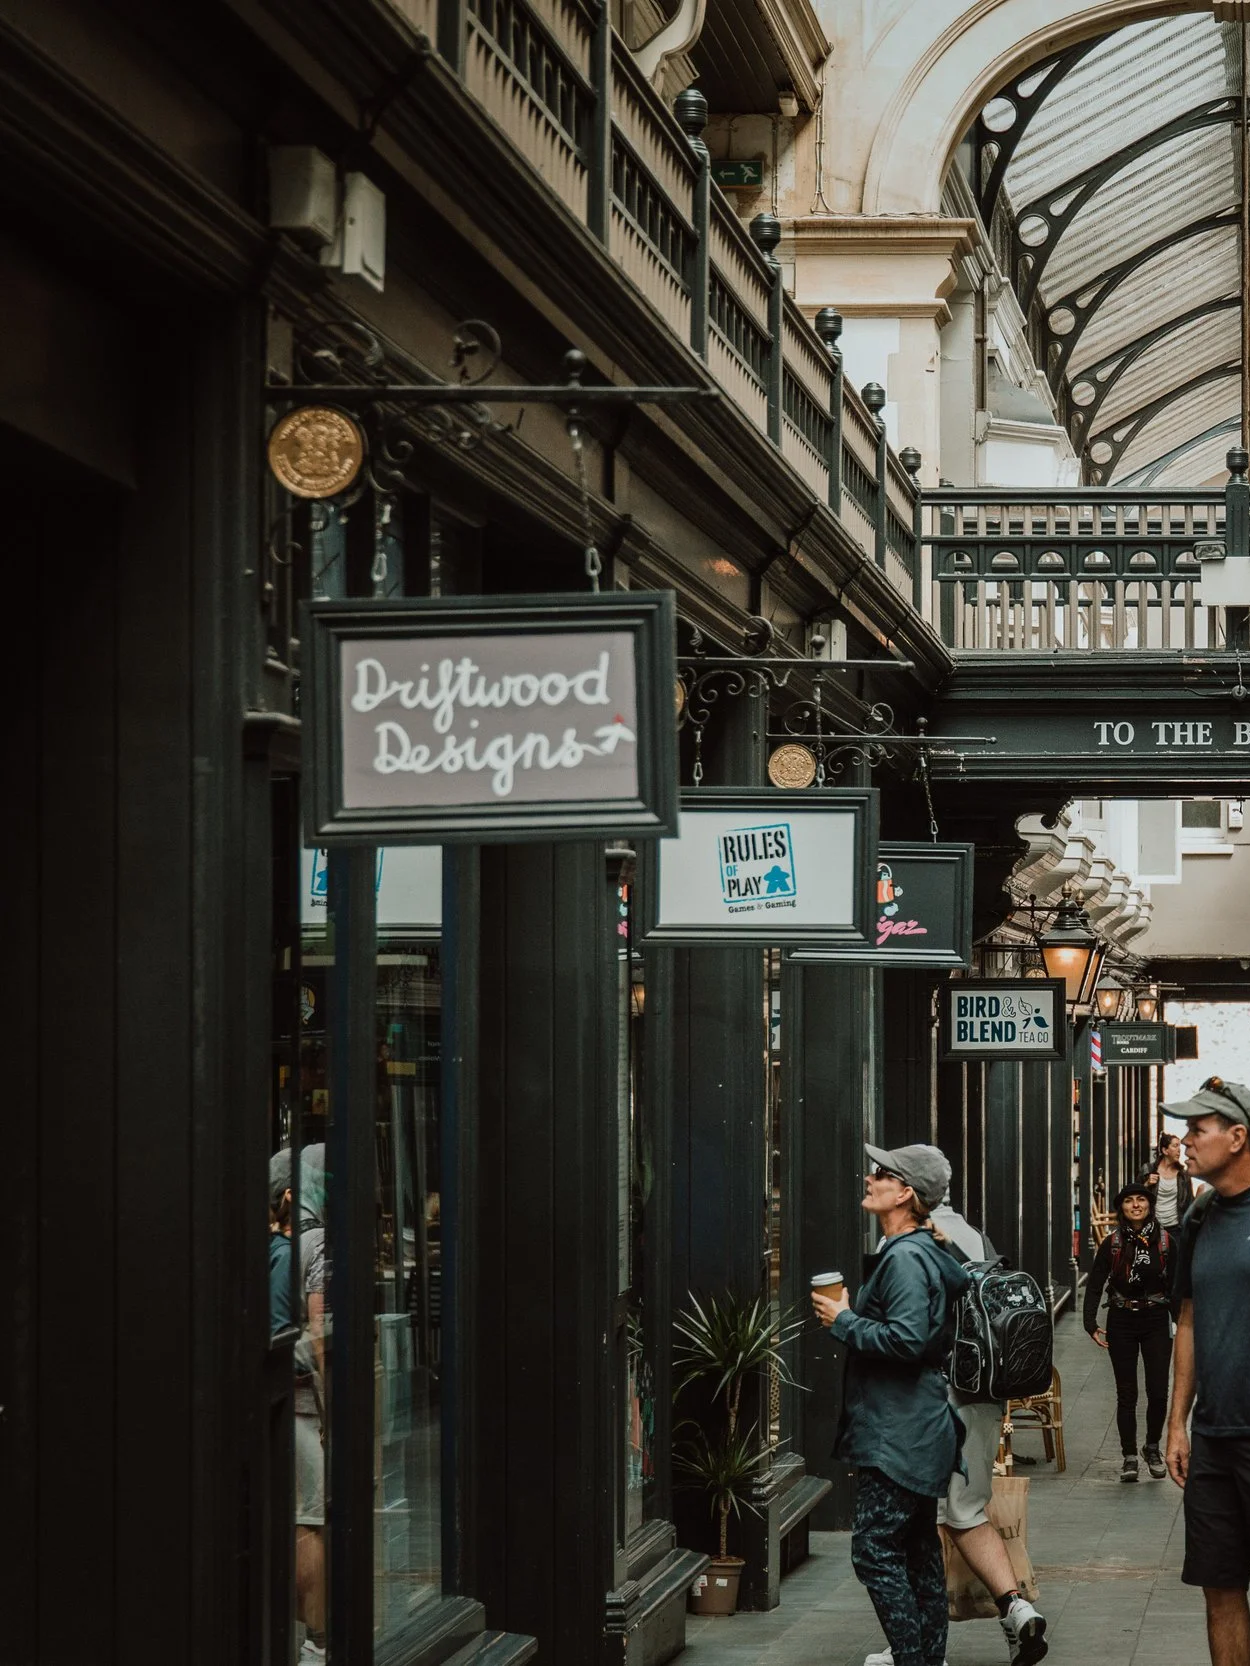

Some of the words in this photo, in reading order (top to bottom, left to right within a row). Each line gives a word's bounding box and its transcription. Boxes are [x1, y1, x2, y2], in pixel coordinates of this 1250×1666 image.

[351, 650, 611, 734] Driftwood
[1093, 721, 1135, 745] TO
[1152, 721, 1213, 745] THE
[373, 719, 585, 796] Designs
[723, 830, 787, 864] RULES
[726, 864, 738, 877] OF
[727, 876, 762, 898] PLAY
[728, 905, 755, 913] Games
[765, 900, 797, 909] Gaming
[957, 996, 1001, 1018] BIRD
[1001, 996, 1017, 1018] &
[957, 1020, 1017, 1043] BLEND
[1019, 1031, 1035, 1043] TEA
[1037, 1031, 1049, 1043] CO
